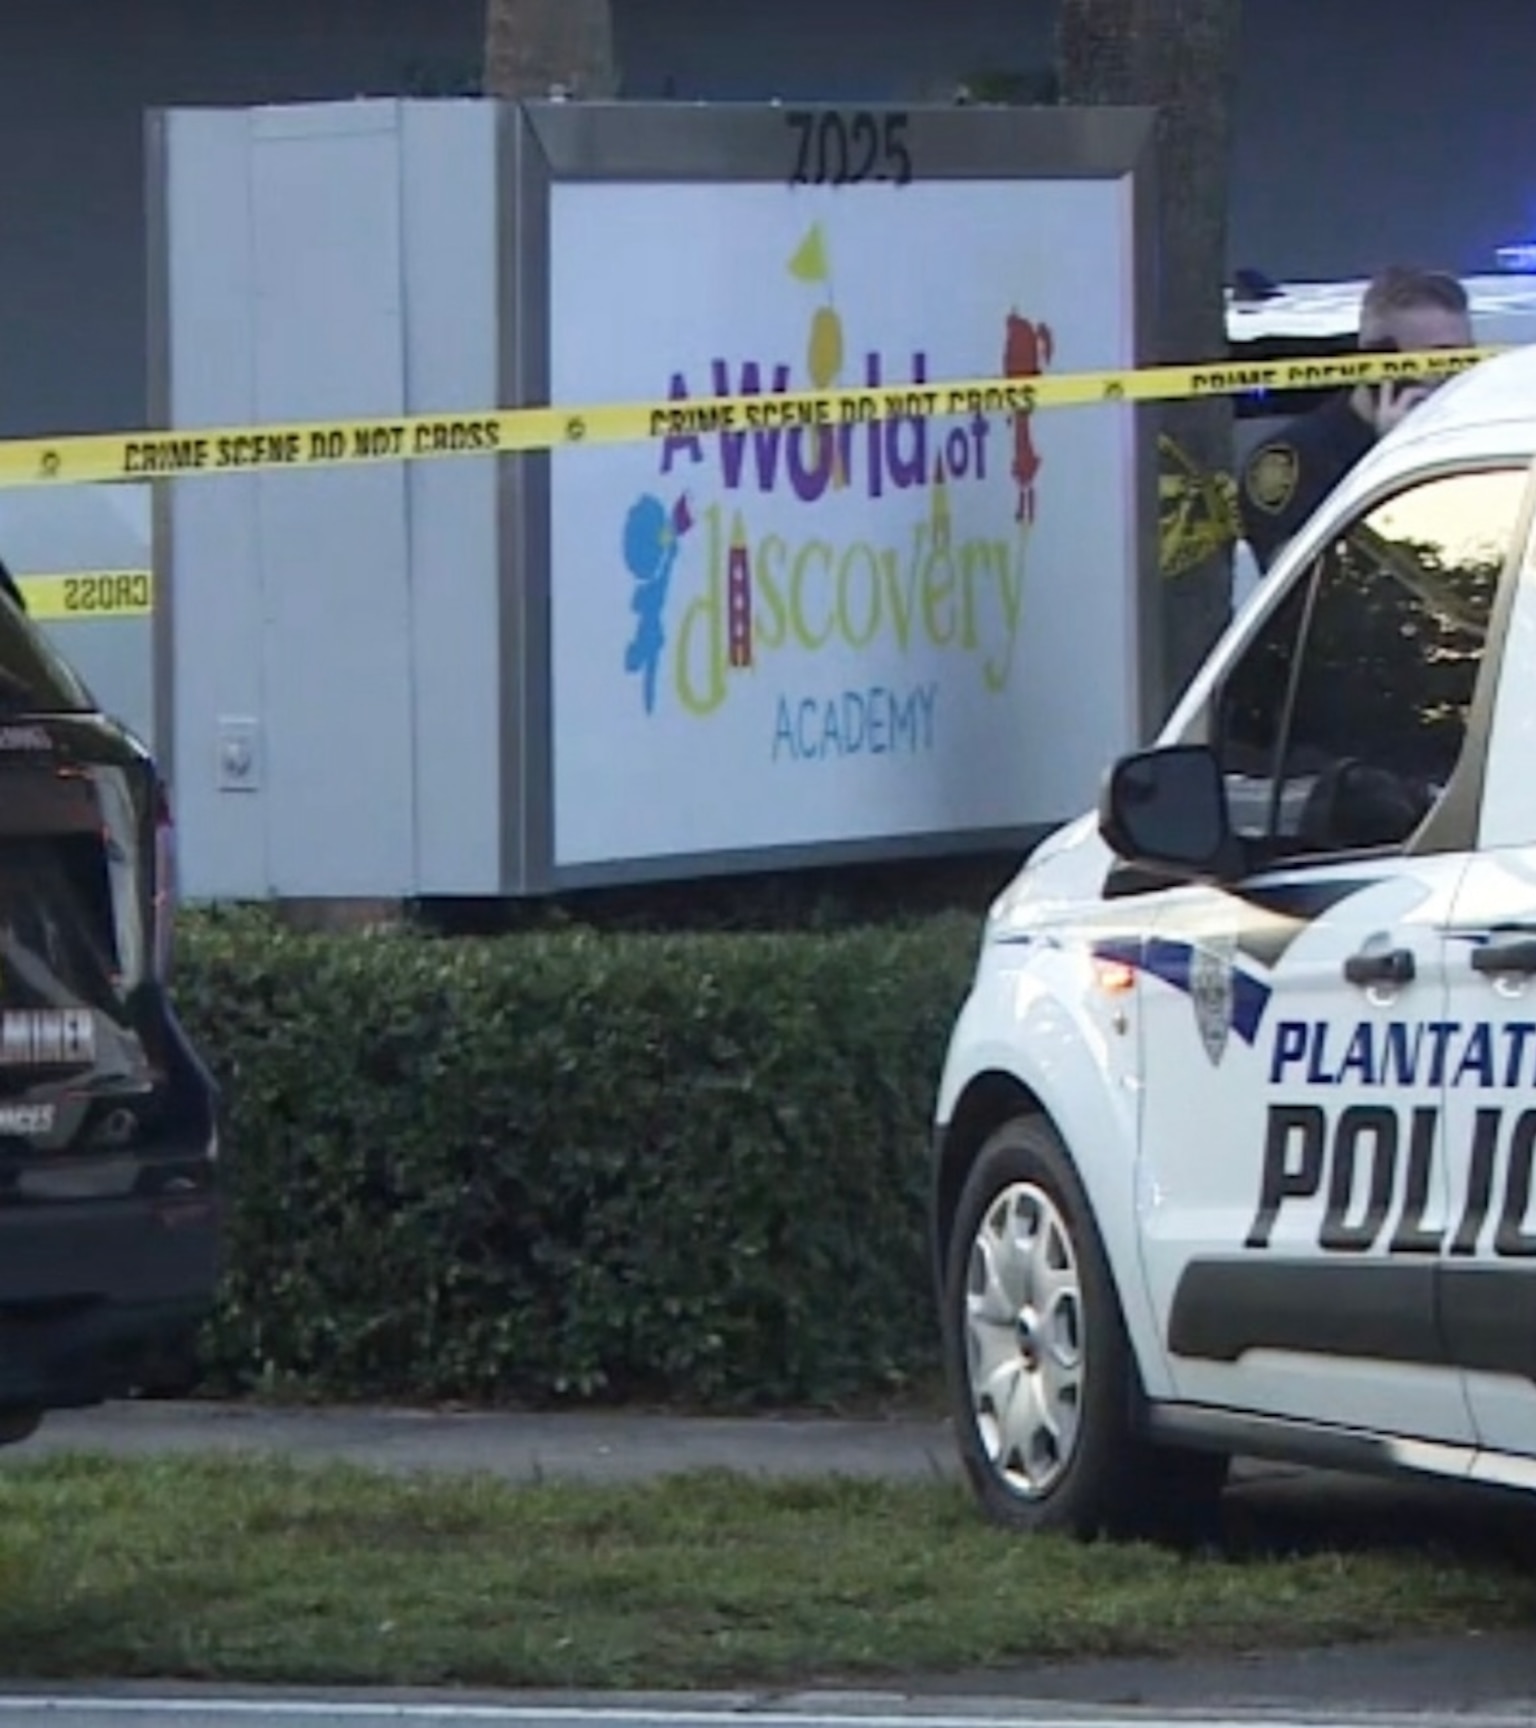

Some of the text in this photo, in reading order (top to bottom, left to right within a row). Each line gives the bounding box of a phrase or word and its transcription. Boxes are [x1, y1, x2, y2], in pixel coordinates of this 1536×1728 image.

[784, 110, 912, 186] 7025
[124, 421, 501, 471] CRIME SCENE DO NOT CROSS
[650, 384, 1038, 437] CRIME SCENE DO NOT CROSS
[660, 373, 703, 475] A
[946, 410, 990, 480] of
[771, 683, 938, 761] ACADEMY
